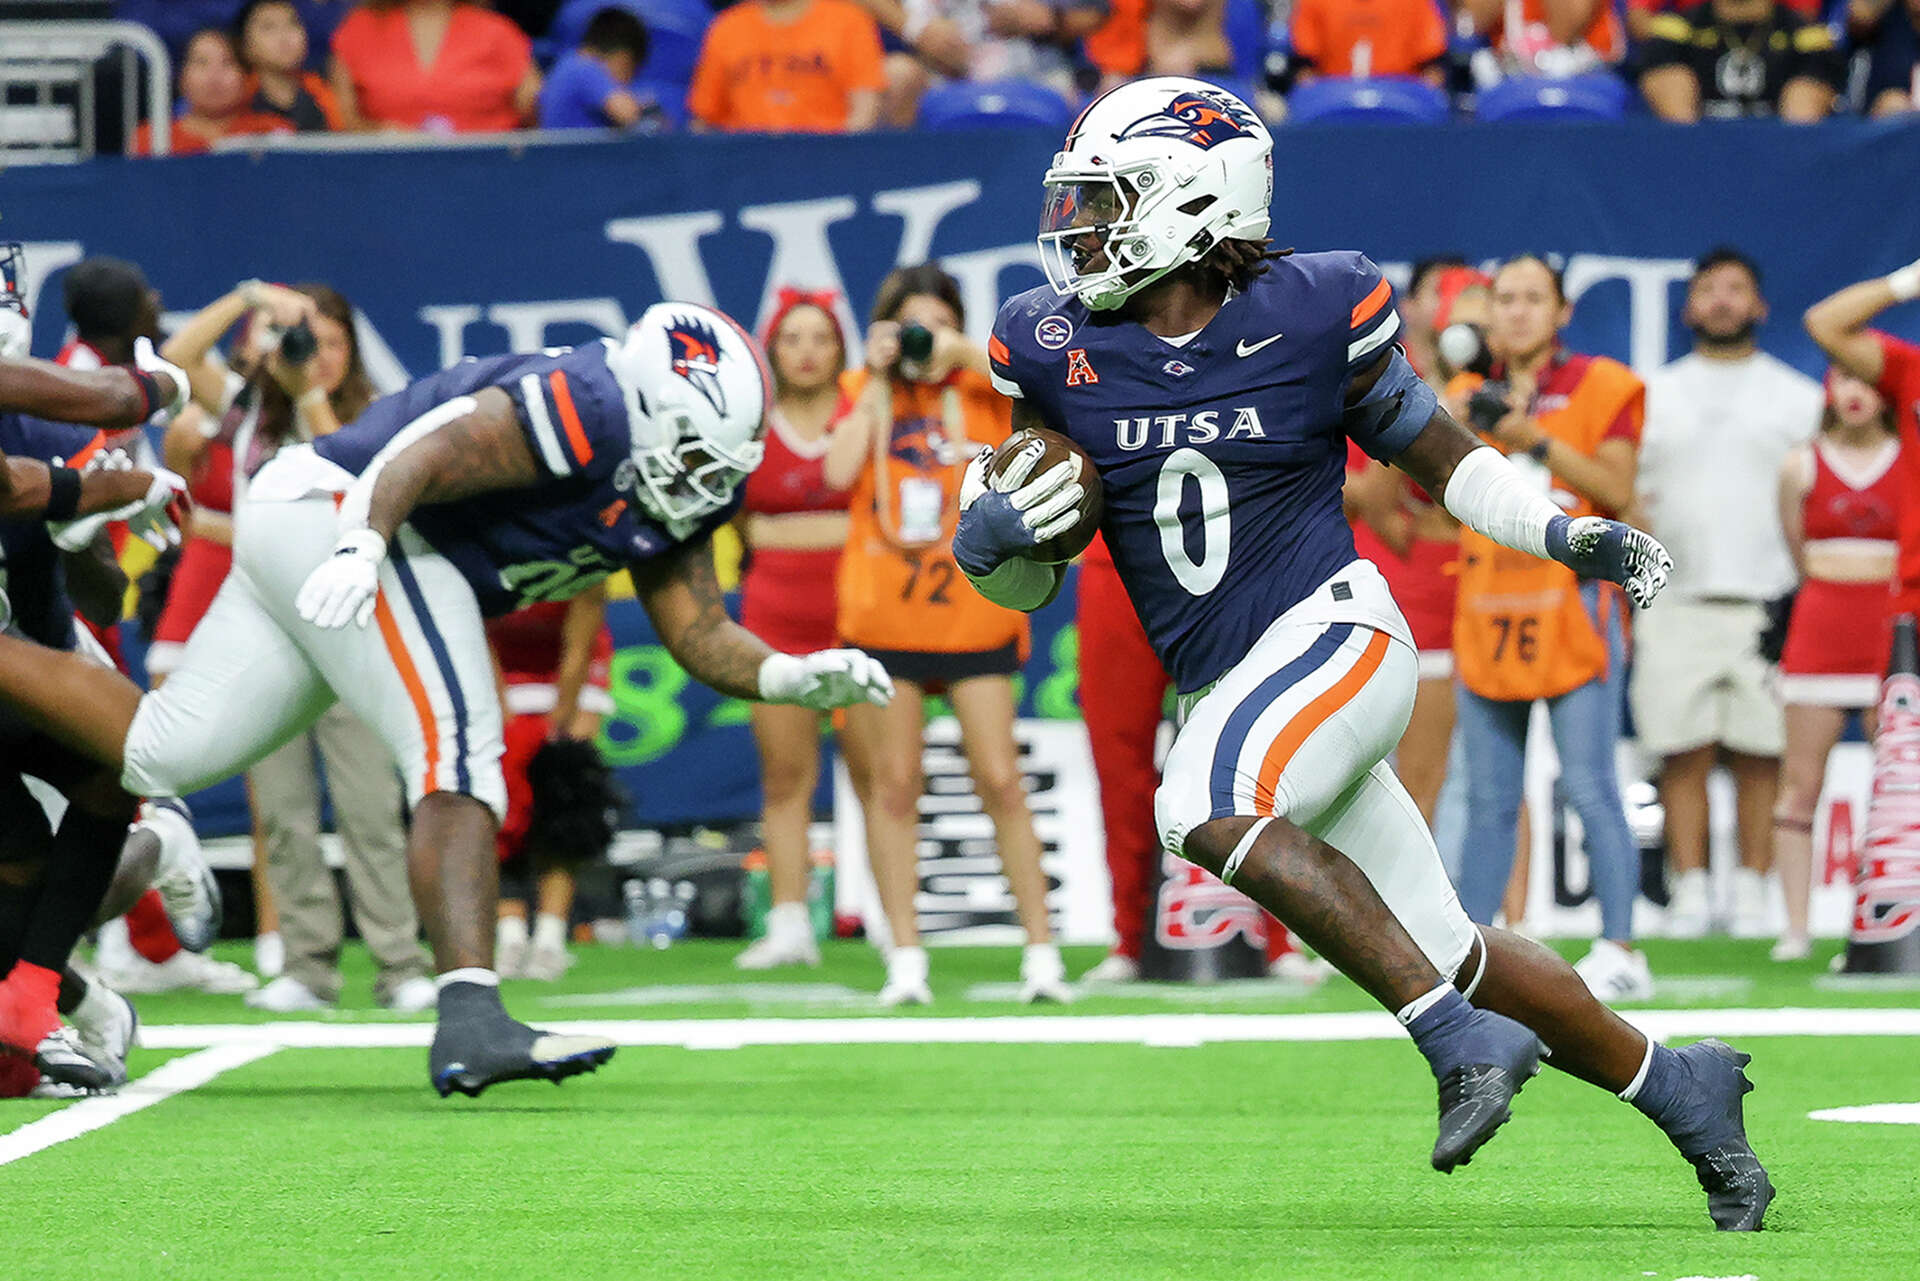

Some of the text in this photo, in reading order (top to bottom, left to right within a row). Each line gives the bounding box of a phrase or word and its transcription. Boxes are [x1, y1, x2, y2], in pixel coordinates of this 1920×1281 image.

[1113, 406, 1267, 451] UTSA
[1153, 447, 1231, 596] 0
[899, 550, 954, 604] 72
[1490, 615, 1539, 665] 76
